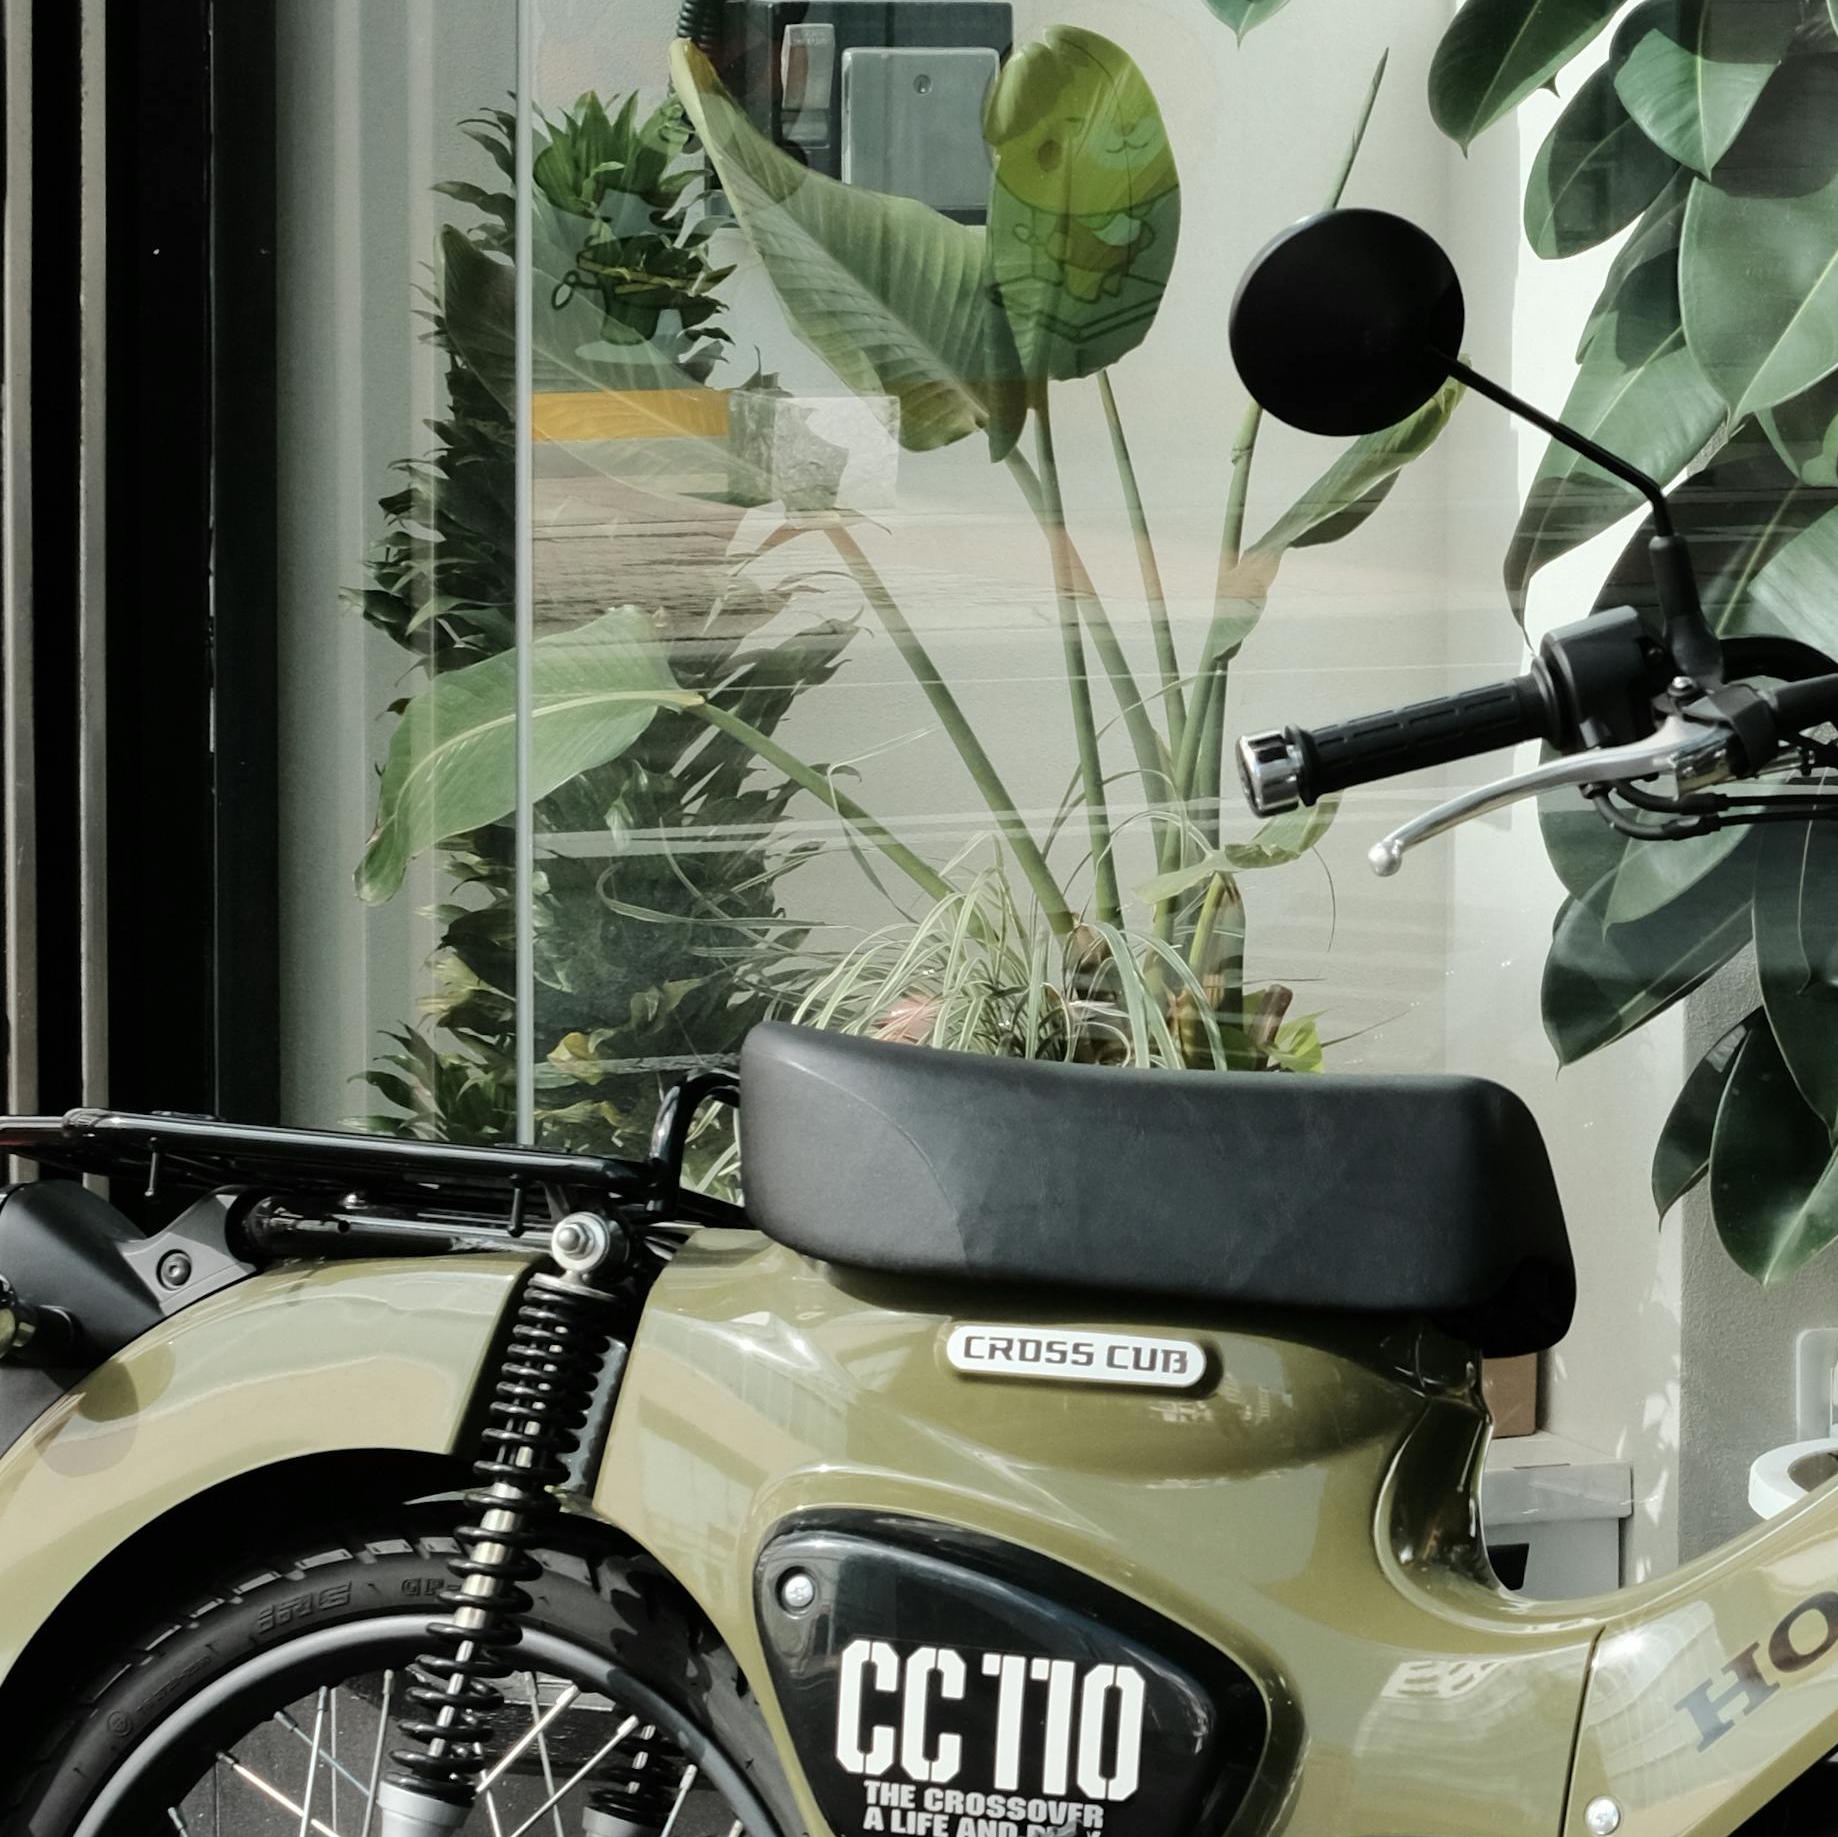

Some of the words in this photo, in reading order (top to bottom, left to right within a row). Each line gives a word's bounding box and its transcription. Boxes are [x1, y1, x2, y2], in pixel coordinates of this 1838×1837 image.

[963, 1334, 1095, 1368] CROSS
[1106, 1344, 1189, 1375] CUB
[863, 1780, 916, 1809] THE
[923, 1787, 1104, 1829] CROSSOVER
[863, 1806, 884, 1831] A
